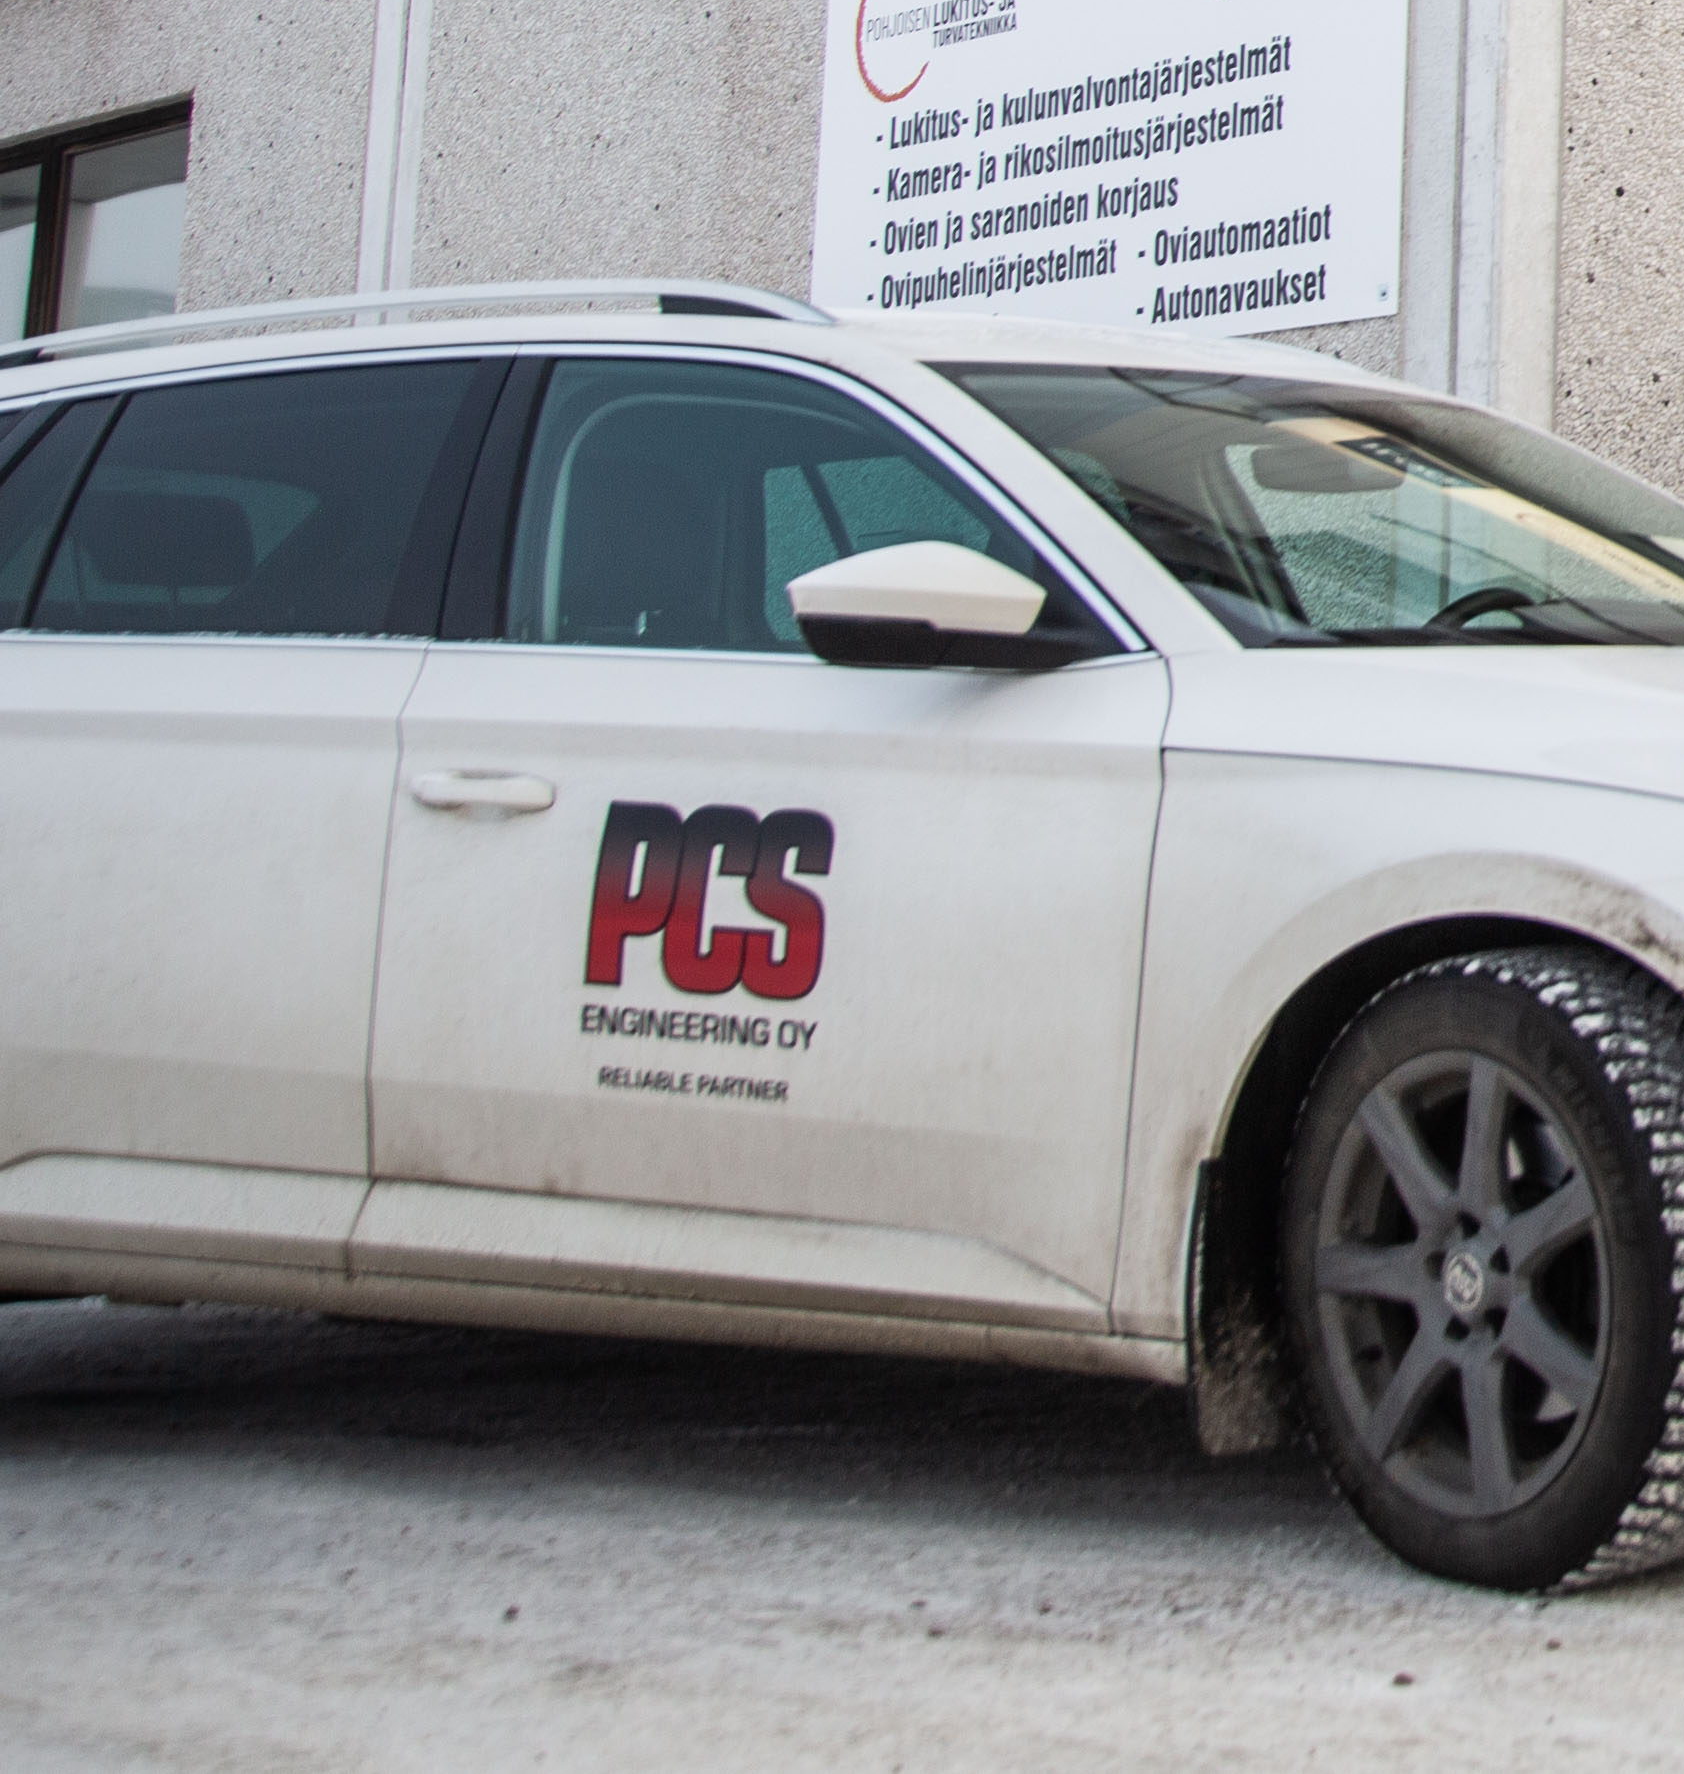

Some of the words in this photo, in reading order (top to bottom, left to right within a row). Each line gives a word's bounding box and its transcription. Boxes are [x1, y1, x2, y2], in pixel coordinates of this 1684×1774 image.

[866, 5, 931, 42] POHJOISEN
[932, 12, 1017, 49] TURVATEKNIIKKA
[889, 107, 969, 150] Lukitus-
[975, 98, 994, 138] ja
[1001, 35, 1292, 128] kulunvalvontajärjestelmät
[887, 161, 971, 202] Kamera-
[978, 151, 997, 191] ja
[1004, 95, 1284, 182] rikosilmoitusjärjestelmät
[884, 217, 938, 255] Ovien
[944, 210, 964, 250] ja
[970, 191, 1089, 241] saranoiden
[1097, 175, 1178, 219] korjaus
[1154, 203, 1332, 267] Oviautomaatiot
[881, 240, 1117, 310] Ovipuhelinjärjestelmät
[1151, 263, 1326, 324] Autonavaukset
[584, 800, 835, 1001] PCS
[580, 1004, 771, 1048] ENGINEERING
[777, 1019, 818, 1050] OY
[598, 1065, 694, 1096] RELIABLE
[697, 1074, 790, 1102] PARTNER
